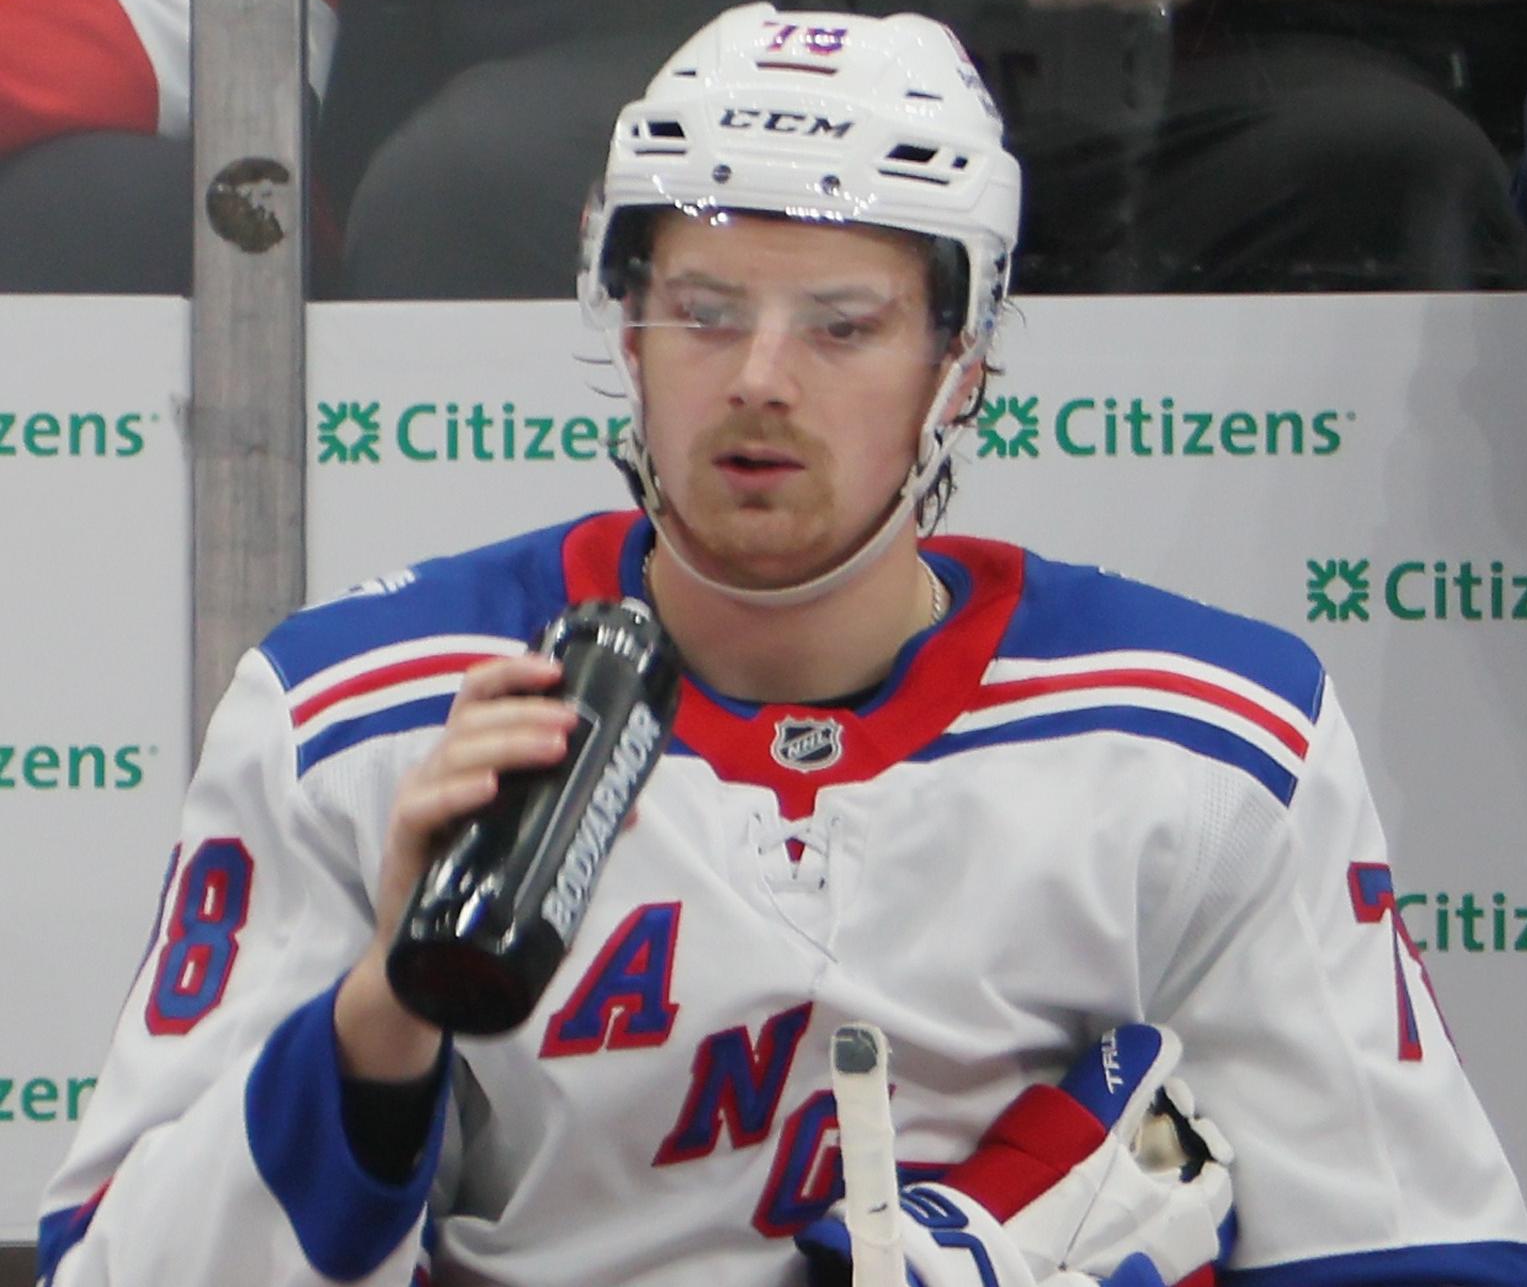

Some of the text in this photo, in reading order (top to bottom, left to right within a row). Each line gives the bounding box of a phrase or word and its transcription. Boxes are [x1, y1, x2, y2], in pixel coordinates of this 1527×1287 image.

[718, 108, 856, 139] CCM
[1056, 397, 1341, 457] Citizens
[541, 701, 661, 947] BODYARMOR
[130, 836, 254, 1037] 8
